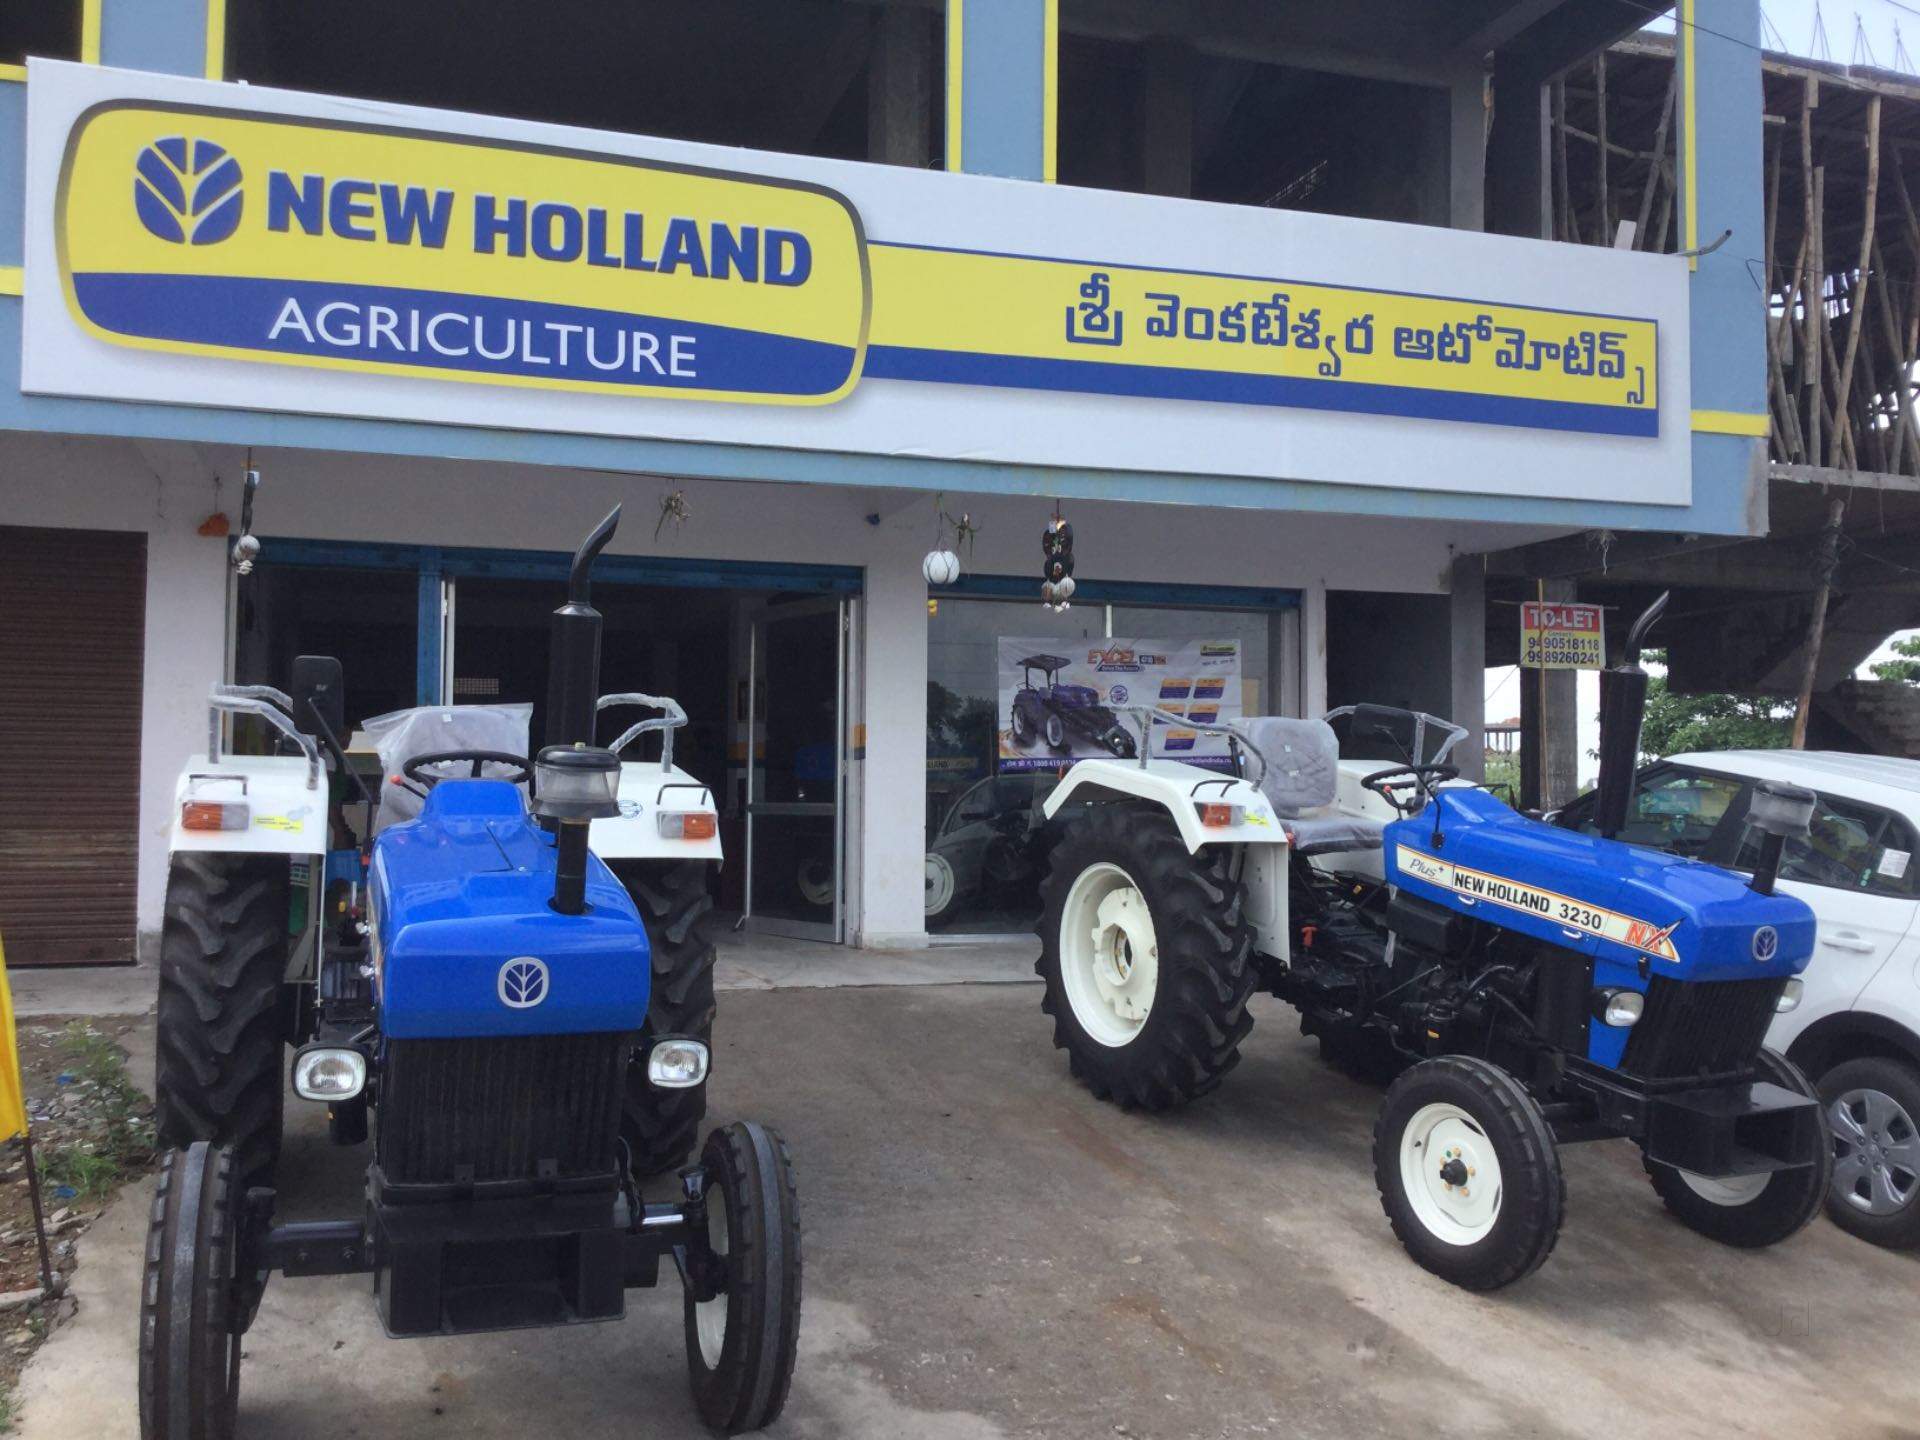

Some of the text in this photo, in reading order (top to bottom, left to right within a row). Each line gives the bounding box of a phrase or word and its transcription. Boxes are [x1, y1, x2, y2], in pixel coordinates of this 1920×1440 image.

[267, 171, 812, 288] NEW HOLLAND
[268, 297, 697, 379] AGRICULTURE
[1065, 272, 1124, 346] శ్రీ
[1144, 292, 1374, 377] వెంకటేశ్వర
[1454, 872, 1485, 894] NEW
[1486, 881, 1550, 913] HOLLAND
[1559, 903, 1602, 930] 3230
